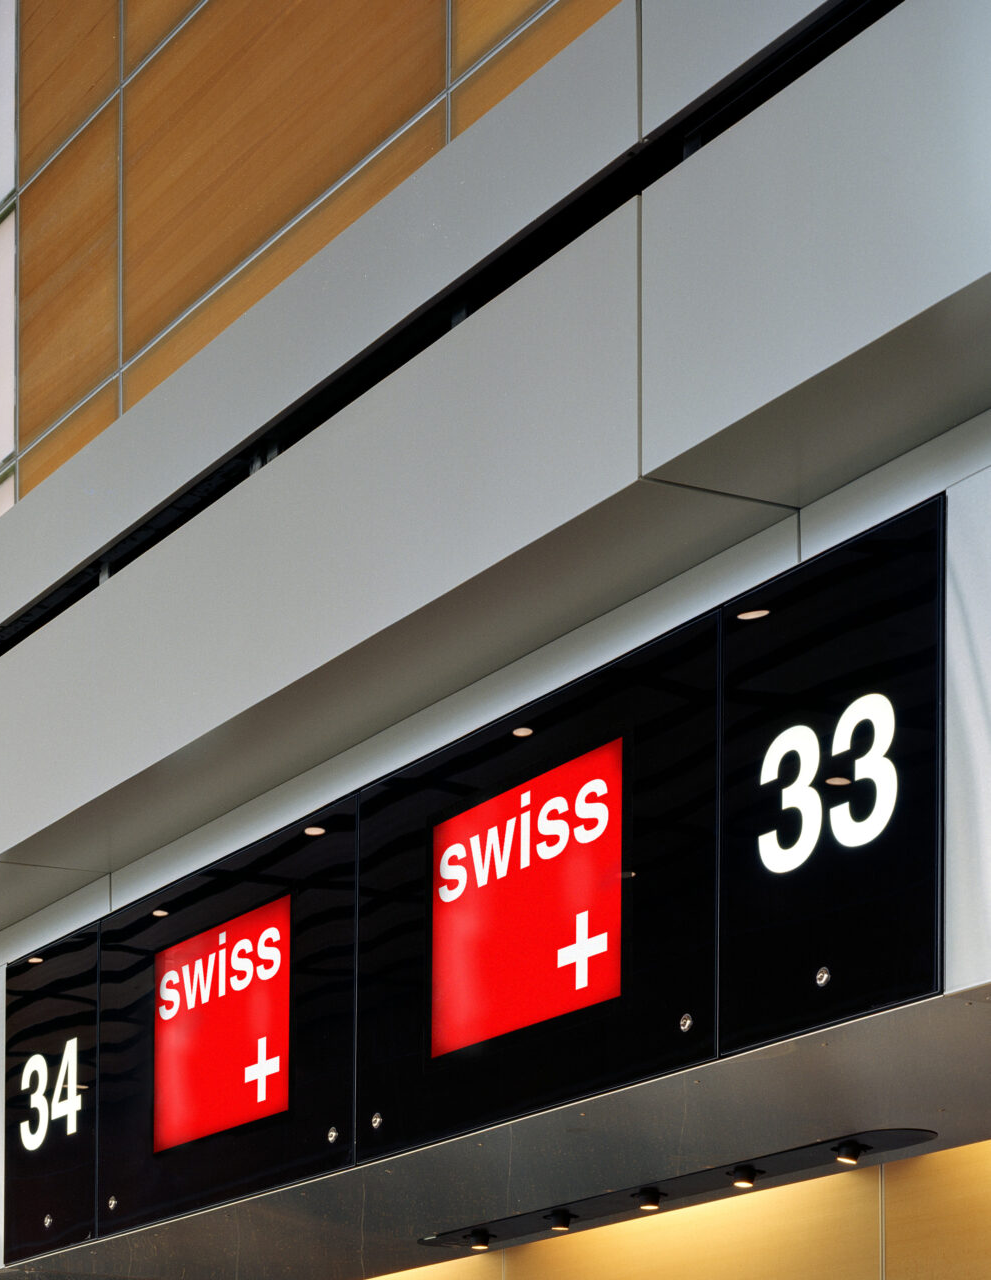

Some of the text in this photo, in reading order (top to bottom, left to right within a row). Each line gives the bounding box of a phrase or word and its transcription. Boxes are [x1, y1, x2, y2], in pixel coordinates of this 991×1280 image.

[438, 778, 609, 903] swiss
[757, 693, 898, 874] 33
[158, 926, 282, 1021] swiss
[19, 1037, 82, 1151] 34
